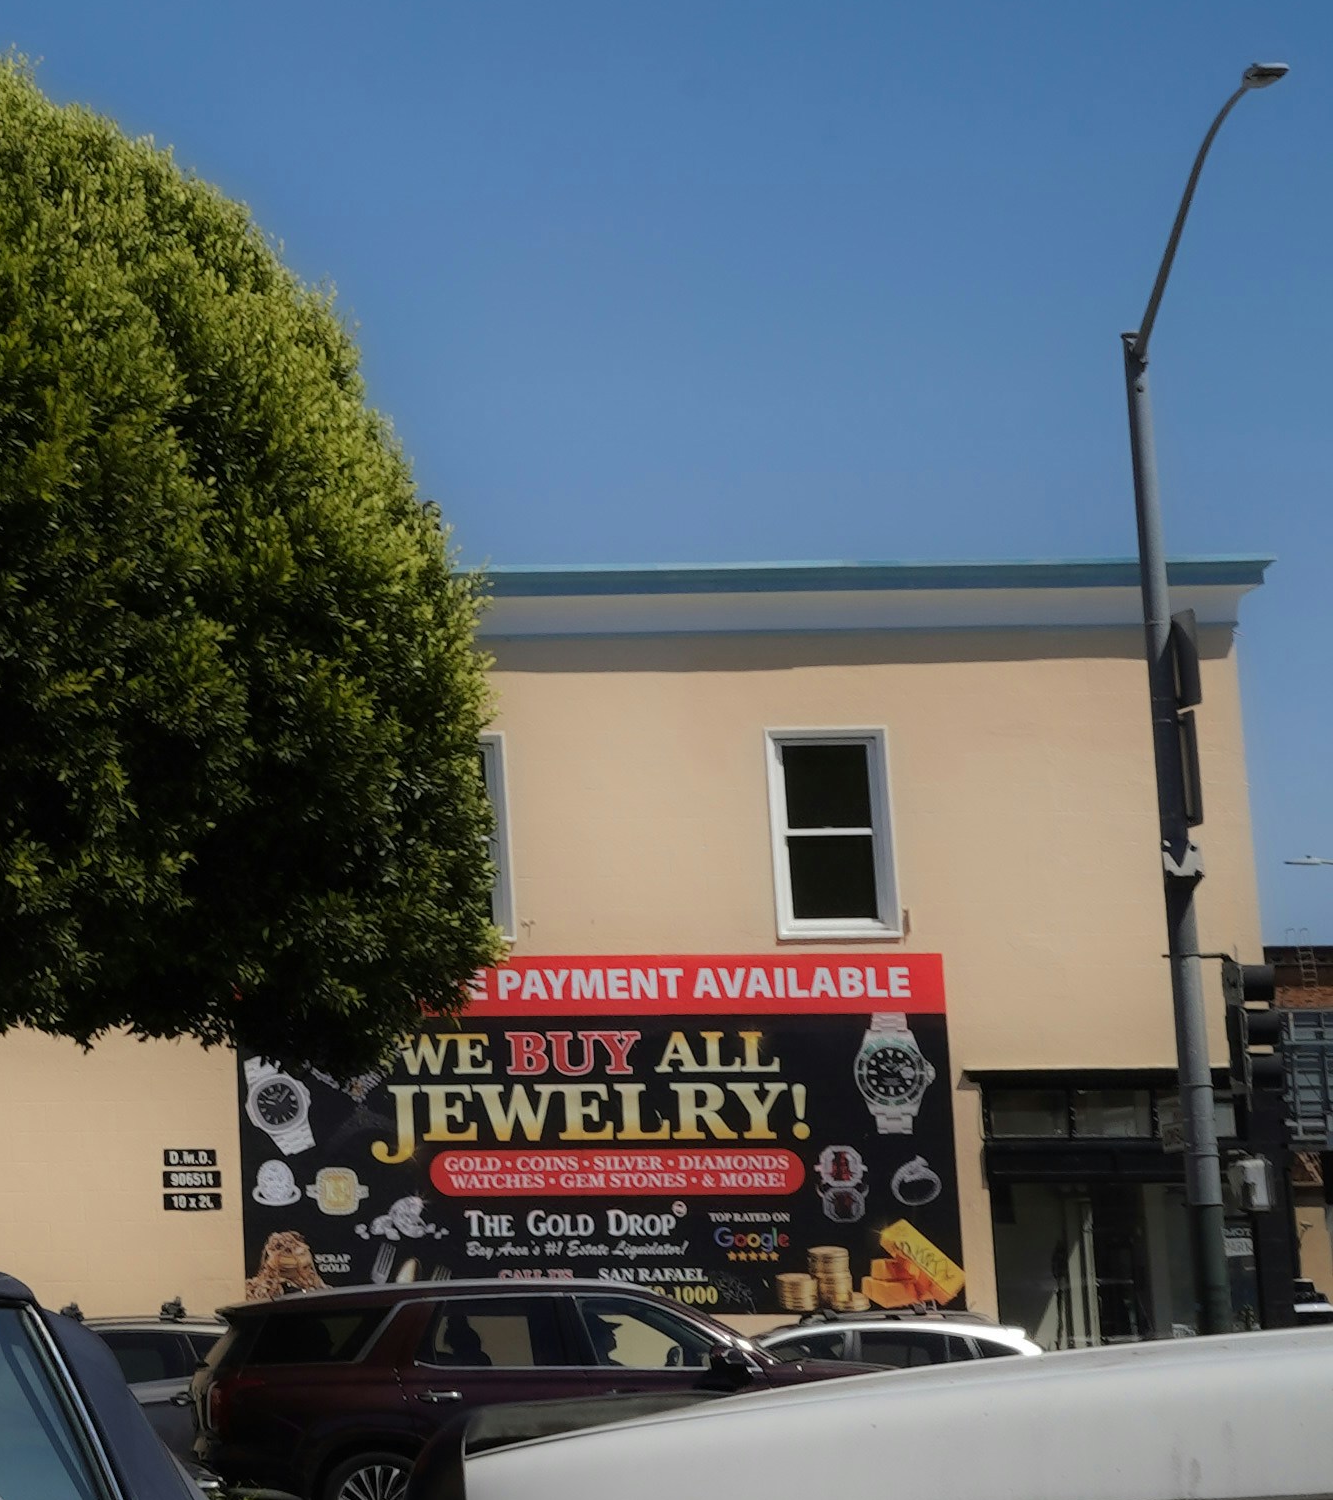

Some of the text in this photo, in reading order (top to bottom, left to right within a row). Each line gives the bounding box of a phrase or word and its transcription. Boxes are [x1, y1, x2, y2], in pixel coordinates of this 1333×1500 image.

[497, 967, 685, 1001] PAYMENT
[693, 966, 912, 999] AVAILABLE
[393, 1031, 781, 1076] WE BUY ALL
[371, 1083, 811, 1164] JEWELRY!
[443, 1154, 790, 1172] GOLD COINS SILVER DIAMONDS
[449, 1172, 787, 1189] WATCHES GEM STONES & MORE!
[463, 1208, 677, 1237] THE GOLD DROP
[707, 1211, 791, 1223] TOP RATED ON
[713, 1226, 791, 1253] Google
[314, 1253, 352, 1264] SCRAP
[465, 1240, 494, 1261] Bay
[544, 1240, 564, 1257] #1
[566, 1239, 610, 1257] Estate
[318, 1263, 351, 1273] GOLD
[598, 1267, 709, 1282] SAN RAFAEL
